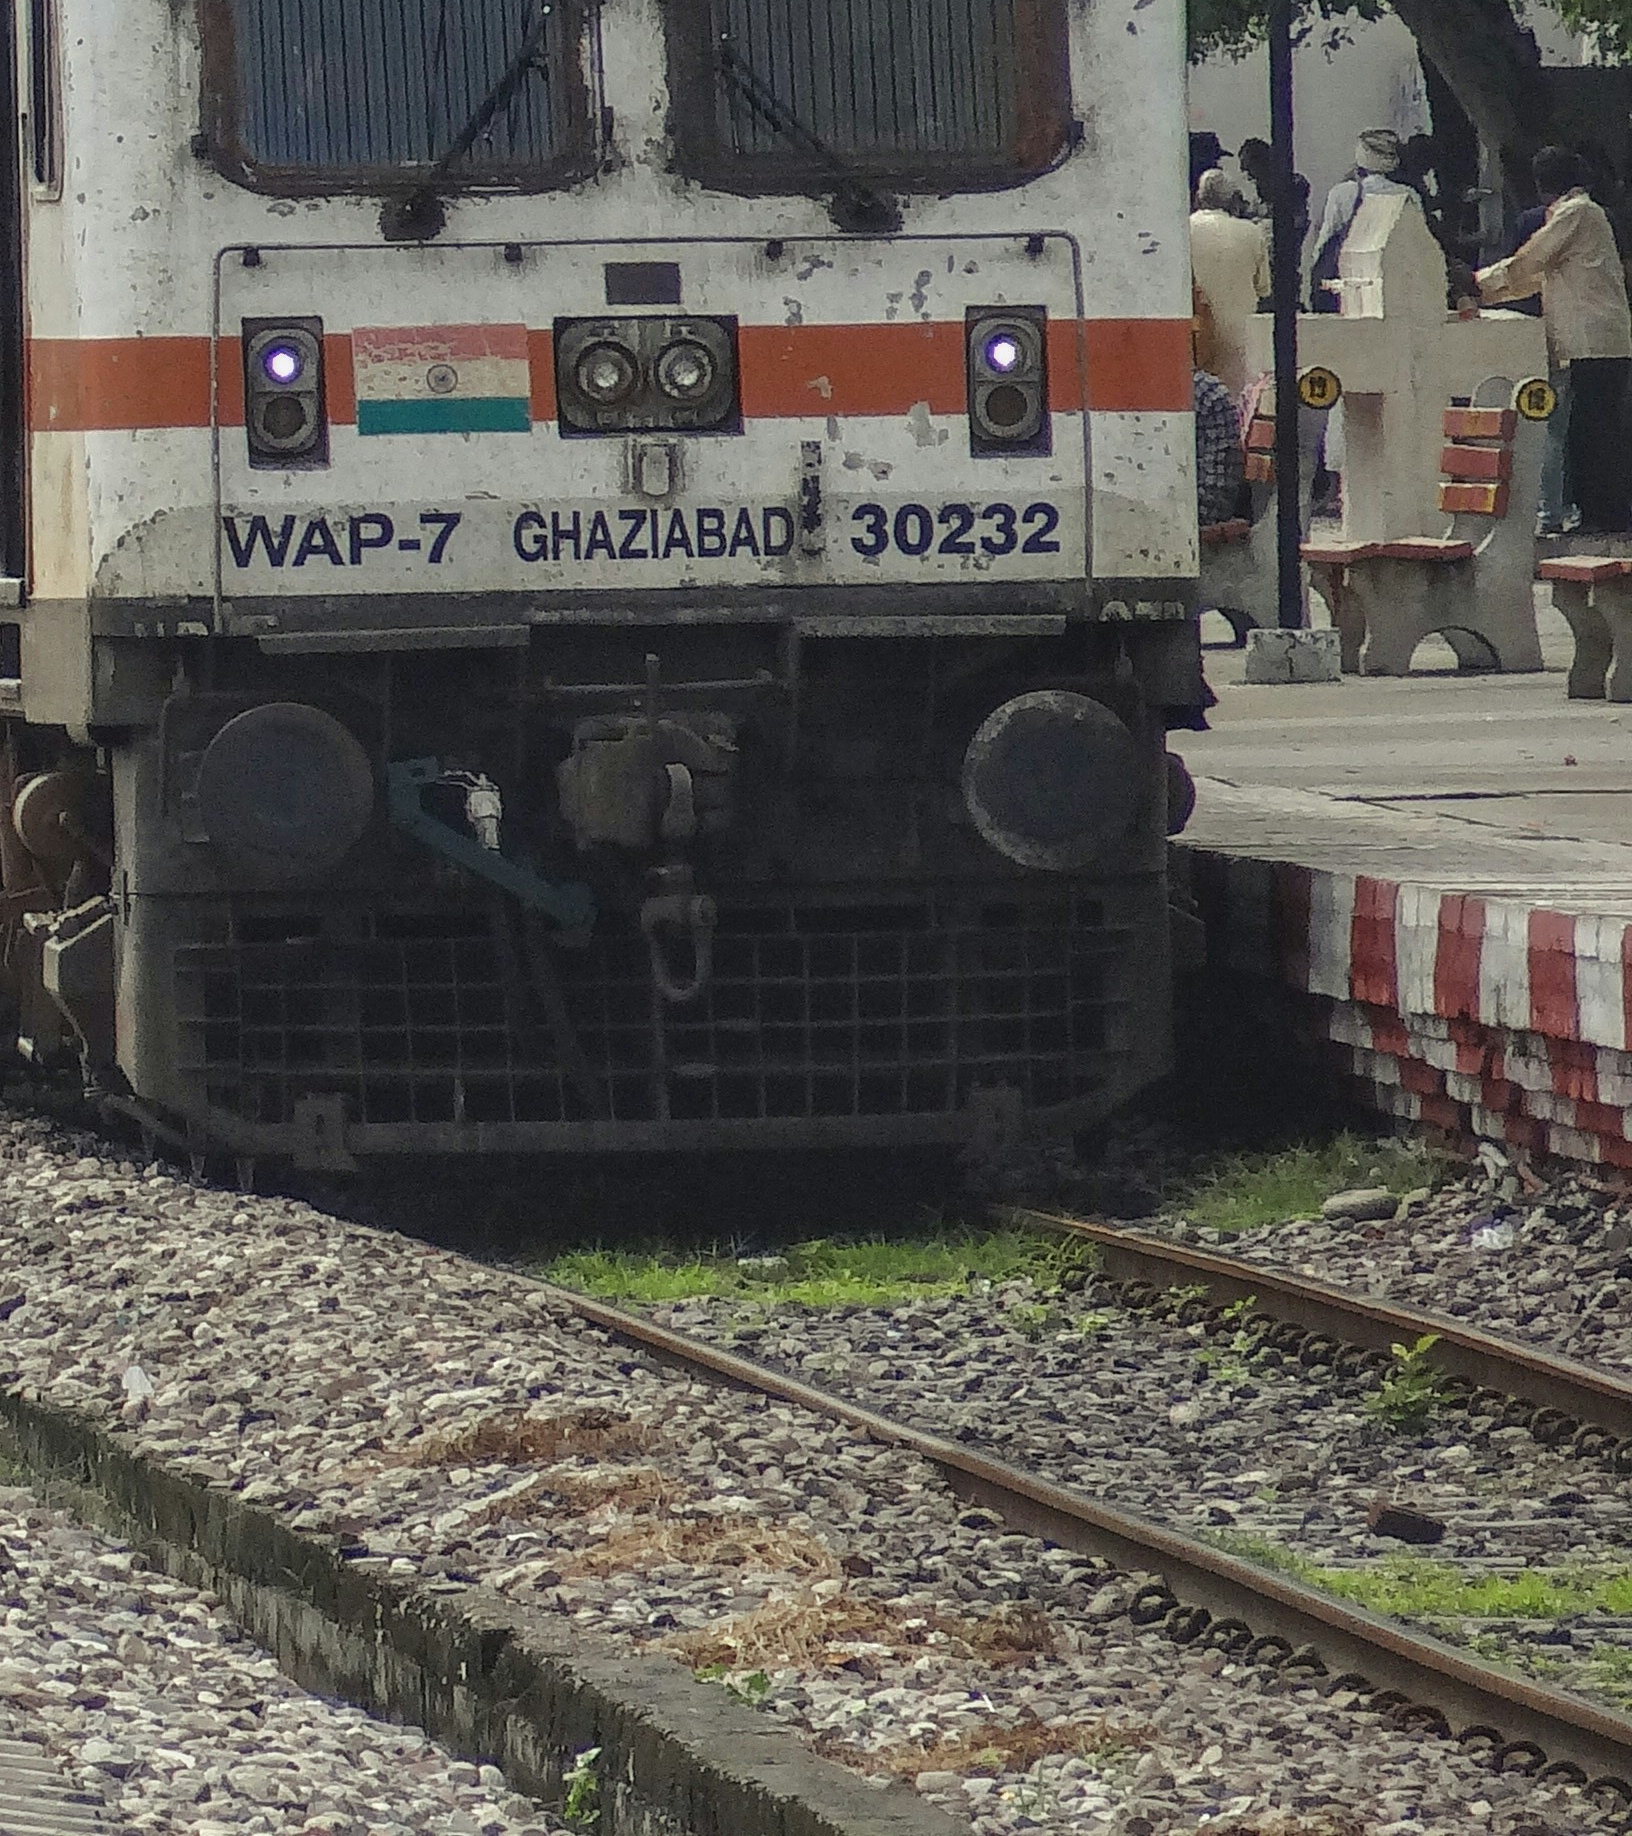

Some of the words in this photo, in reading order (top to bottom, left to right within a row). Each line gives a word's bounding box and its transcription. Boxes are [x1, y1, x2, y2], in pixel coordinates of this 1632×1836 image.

[222, 513, 462, 568] WAP-7
[513, 507, 795, 562] GHAZIABAD
[850, 502, 1061, 556] 30232
